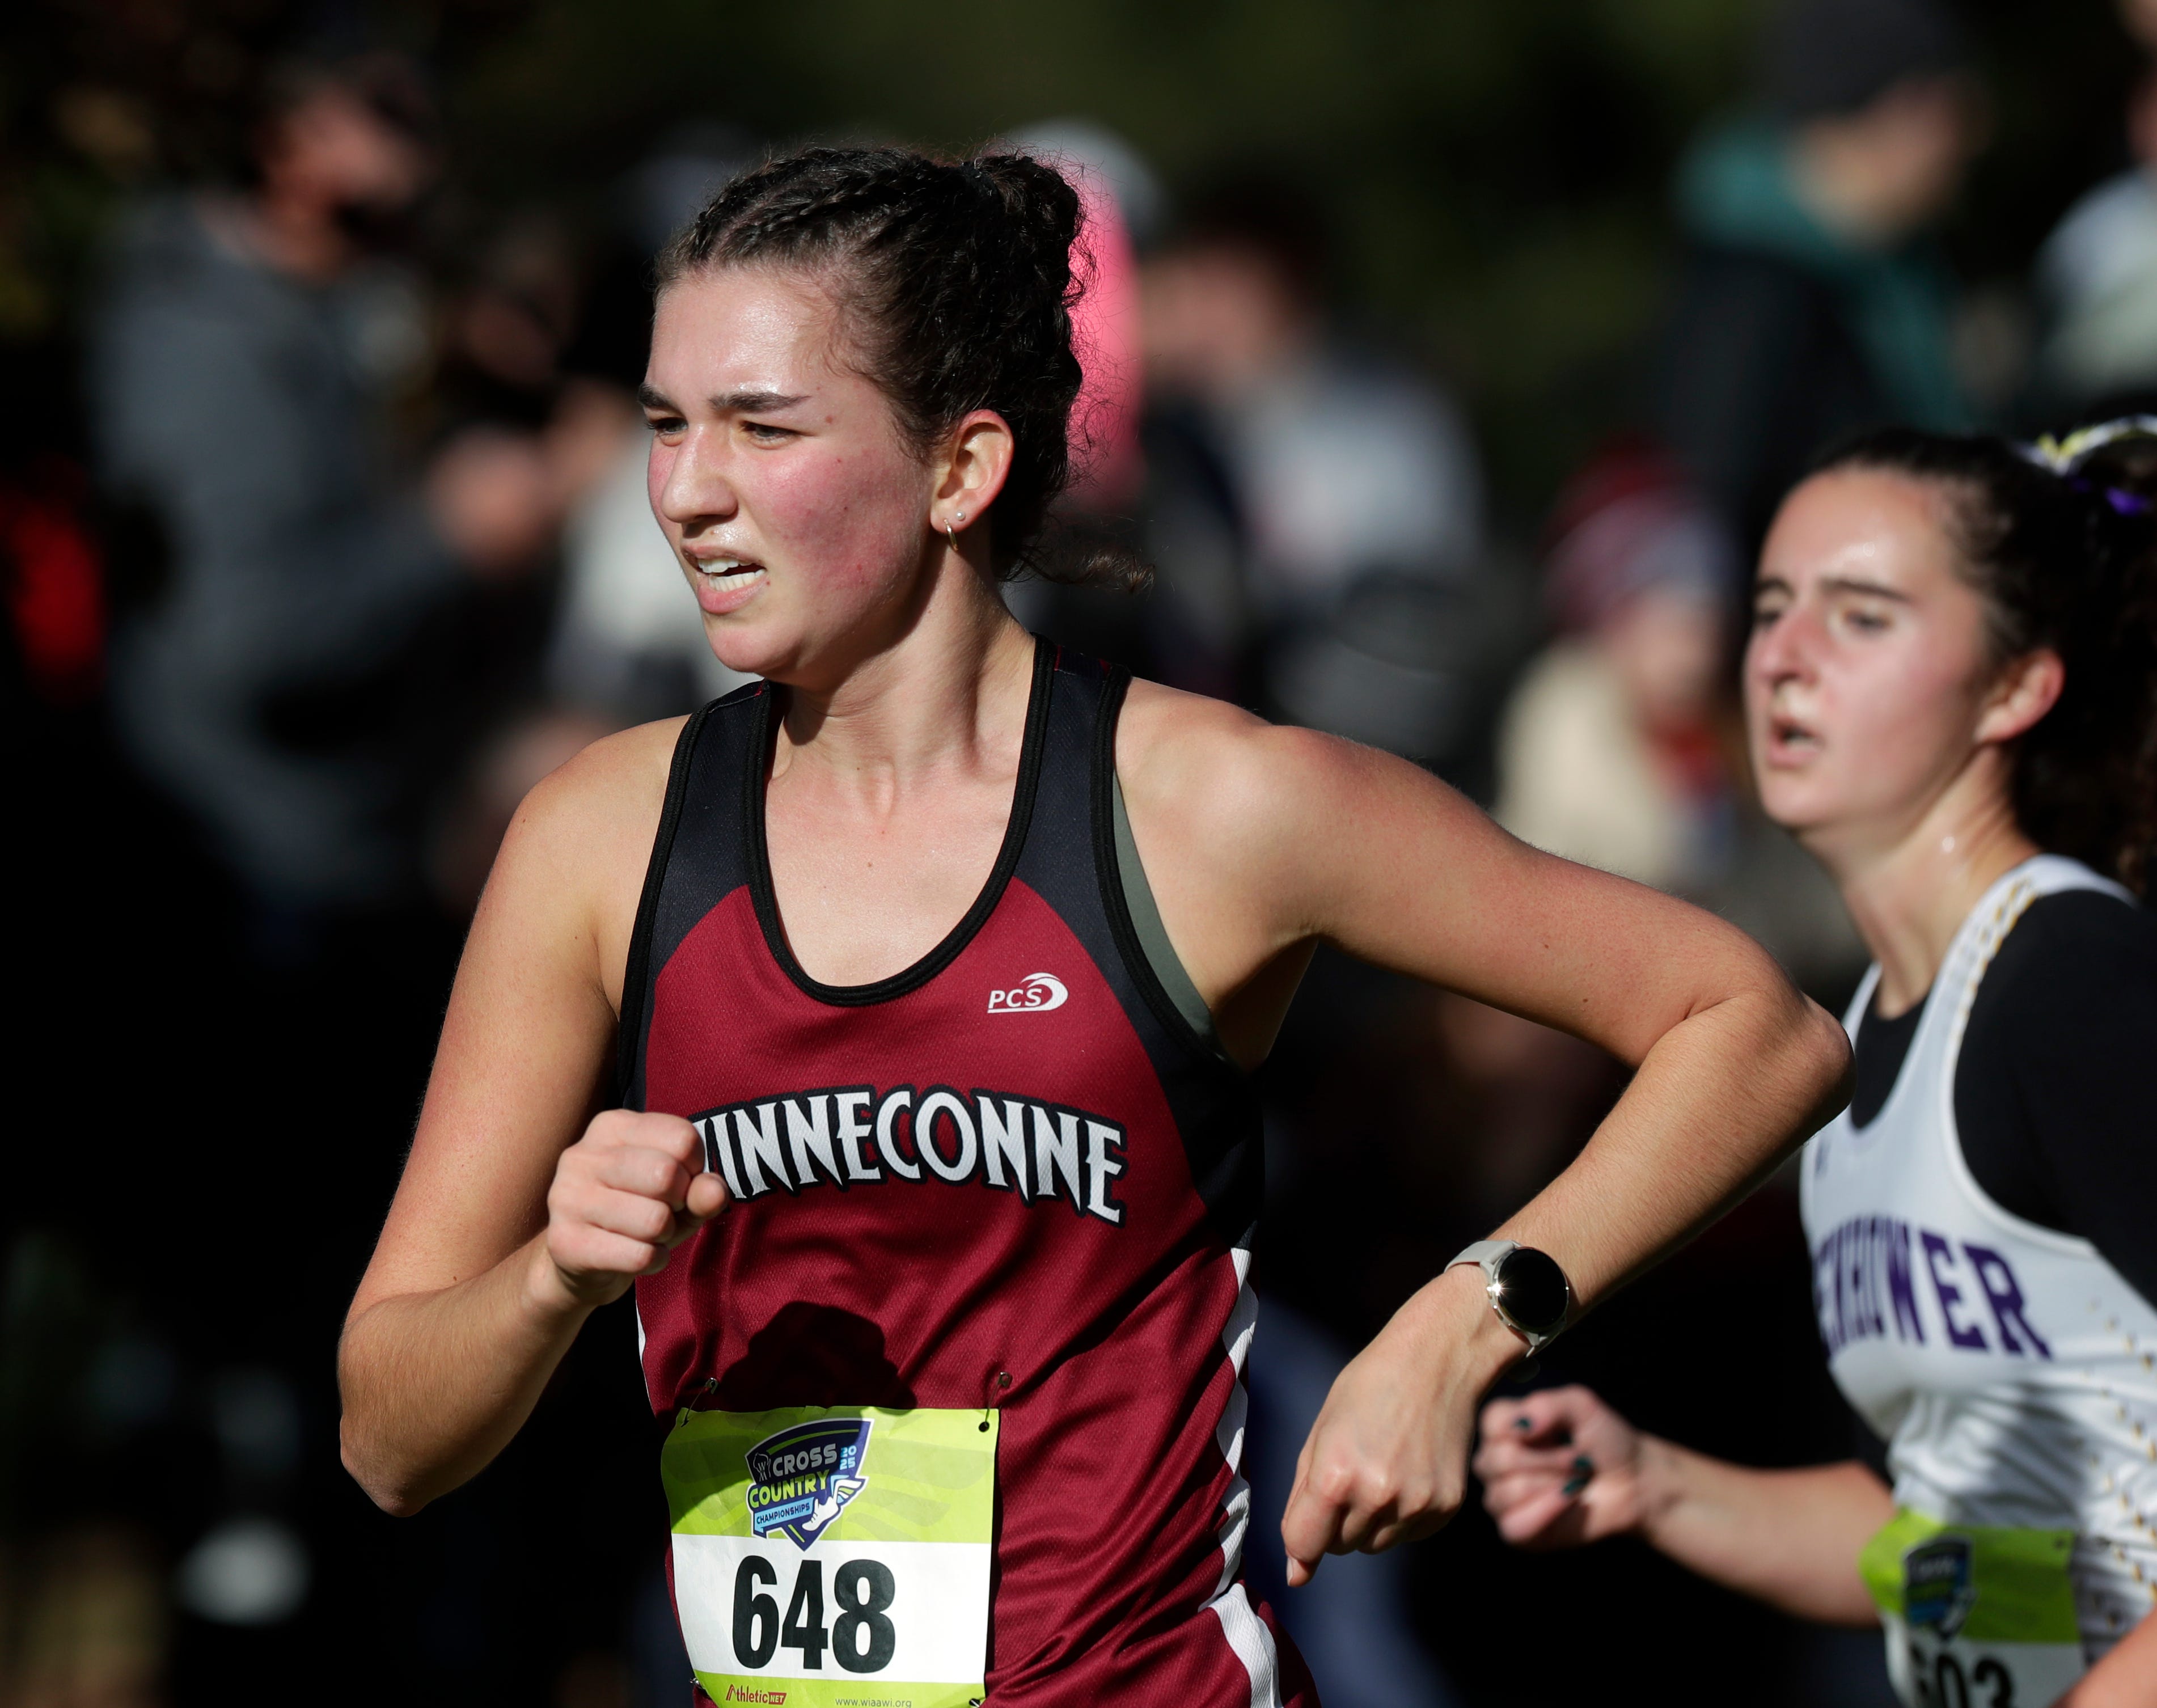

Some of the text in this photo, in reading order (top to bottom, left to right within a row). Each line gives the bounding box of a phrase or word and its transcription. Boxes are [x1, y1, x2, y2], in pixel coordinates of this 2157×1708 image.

[988, 988, 1043, 1009] PCS
[772, 1443, 838, 1477] CROSS
[749, 1469, 830, 1508] COUNTRY
[756, 1502, 811, 1525] CHAMPIONSHIPS
[732, 1555, 896, 1673] 648
[835, 1697, 912, 1708] www.wiaawi.org
